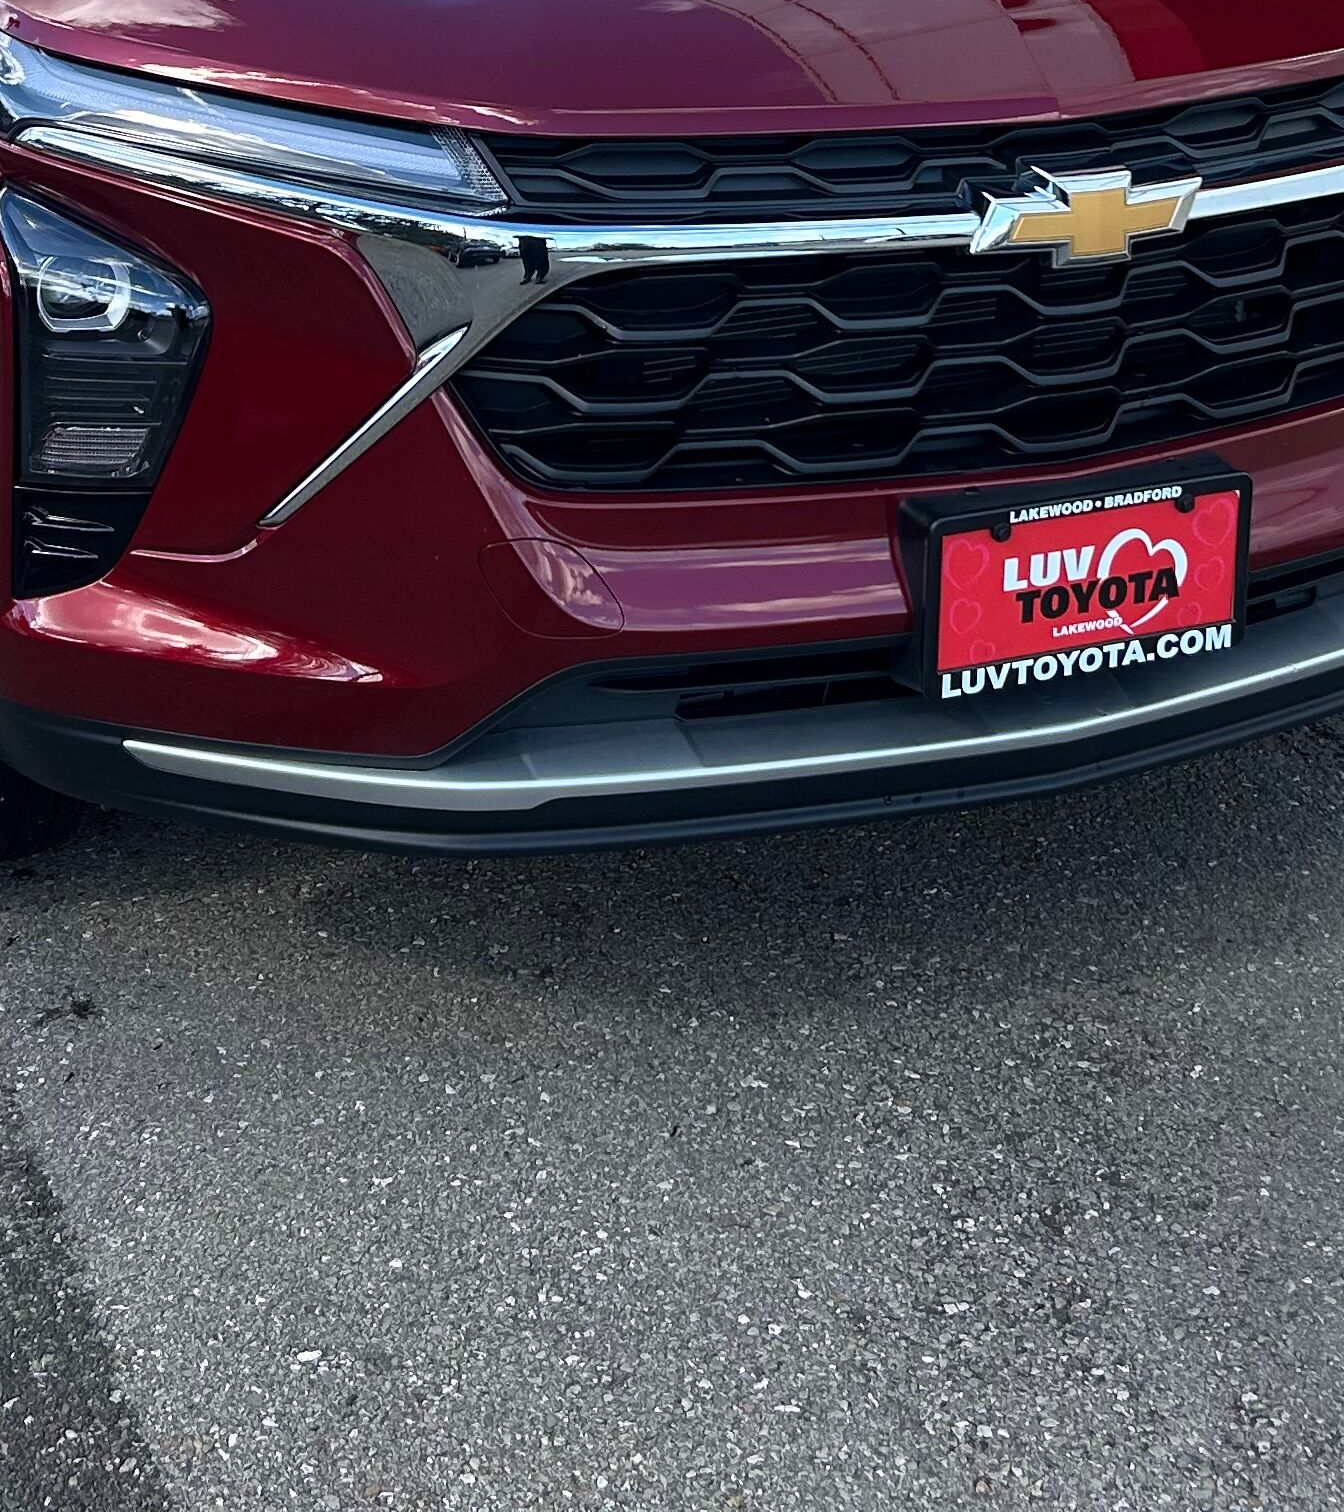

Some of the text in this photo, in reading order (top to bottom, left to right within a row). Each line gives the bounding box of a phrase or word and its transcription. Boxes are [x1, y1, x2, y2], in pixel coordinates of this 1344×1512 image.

[1009, 485, 1183, 523] LAKEWOOD BRADFORD
[1002, 544, 1096, 593] LUV
[1014, 566, 1180, 624] TOYOTA
[1052, 615, 1124, 638] LAKEWOOD
[941, 624, 1233, 699] LUVTOYOTA.COM
